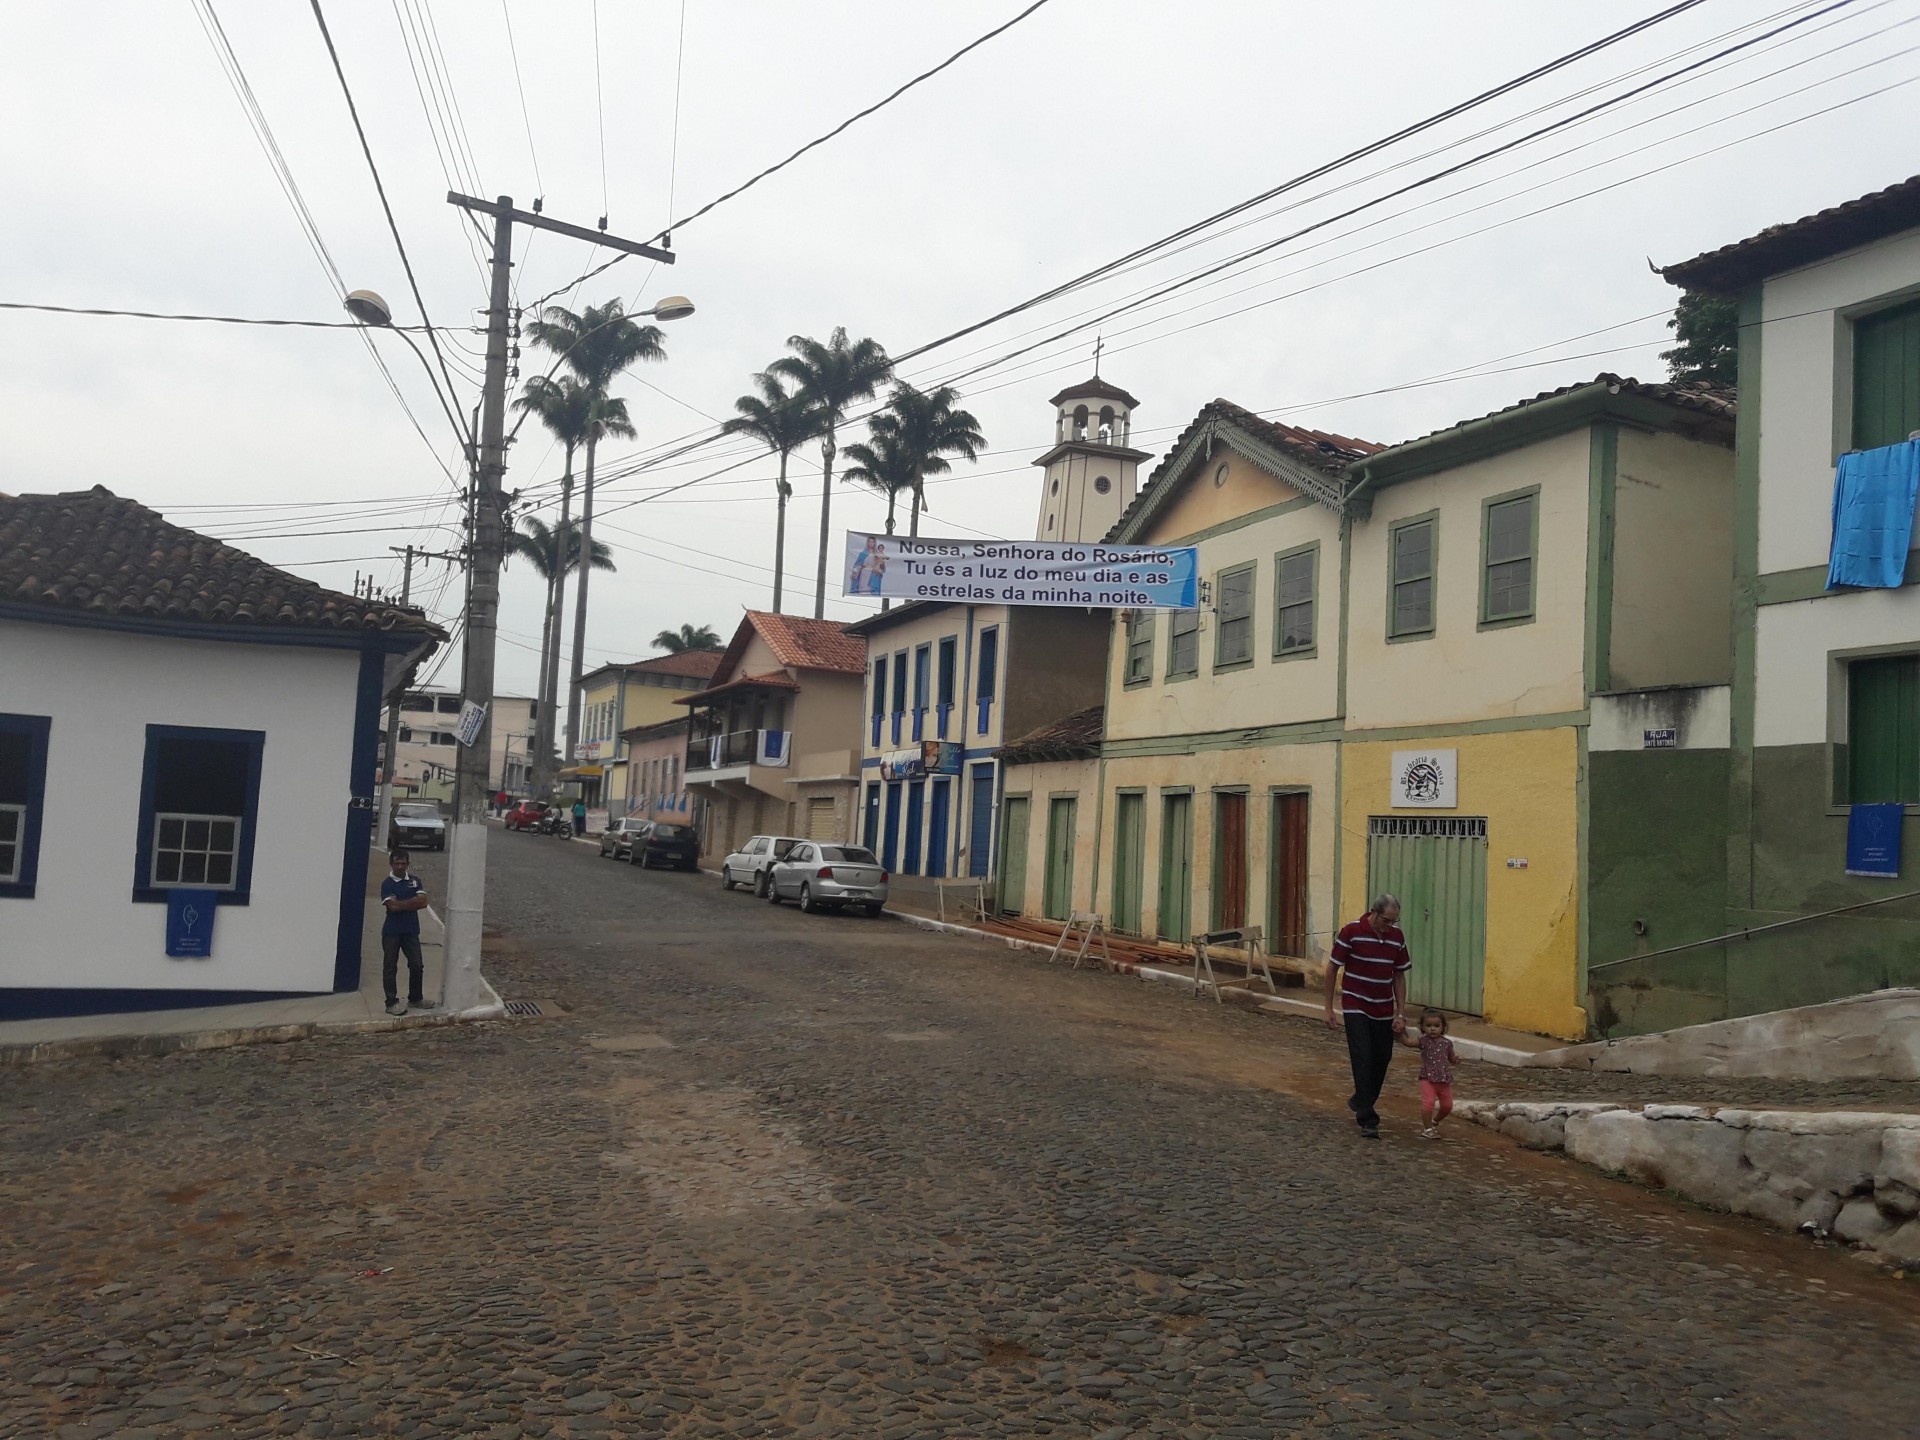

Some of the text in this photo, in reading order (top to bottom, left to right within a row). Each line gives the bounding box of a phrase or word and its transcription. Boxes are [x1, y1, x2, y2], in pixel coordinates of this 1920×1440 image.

[899, 540, 1175, 567] Nossa, Senhora do Rosário,
[903, 559, 1169, 585] Tu és a luz do meu dia e as
[917, 583, 1153, 605] estrelas da minha noite.
